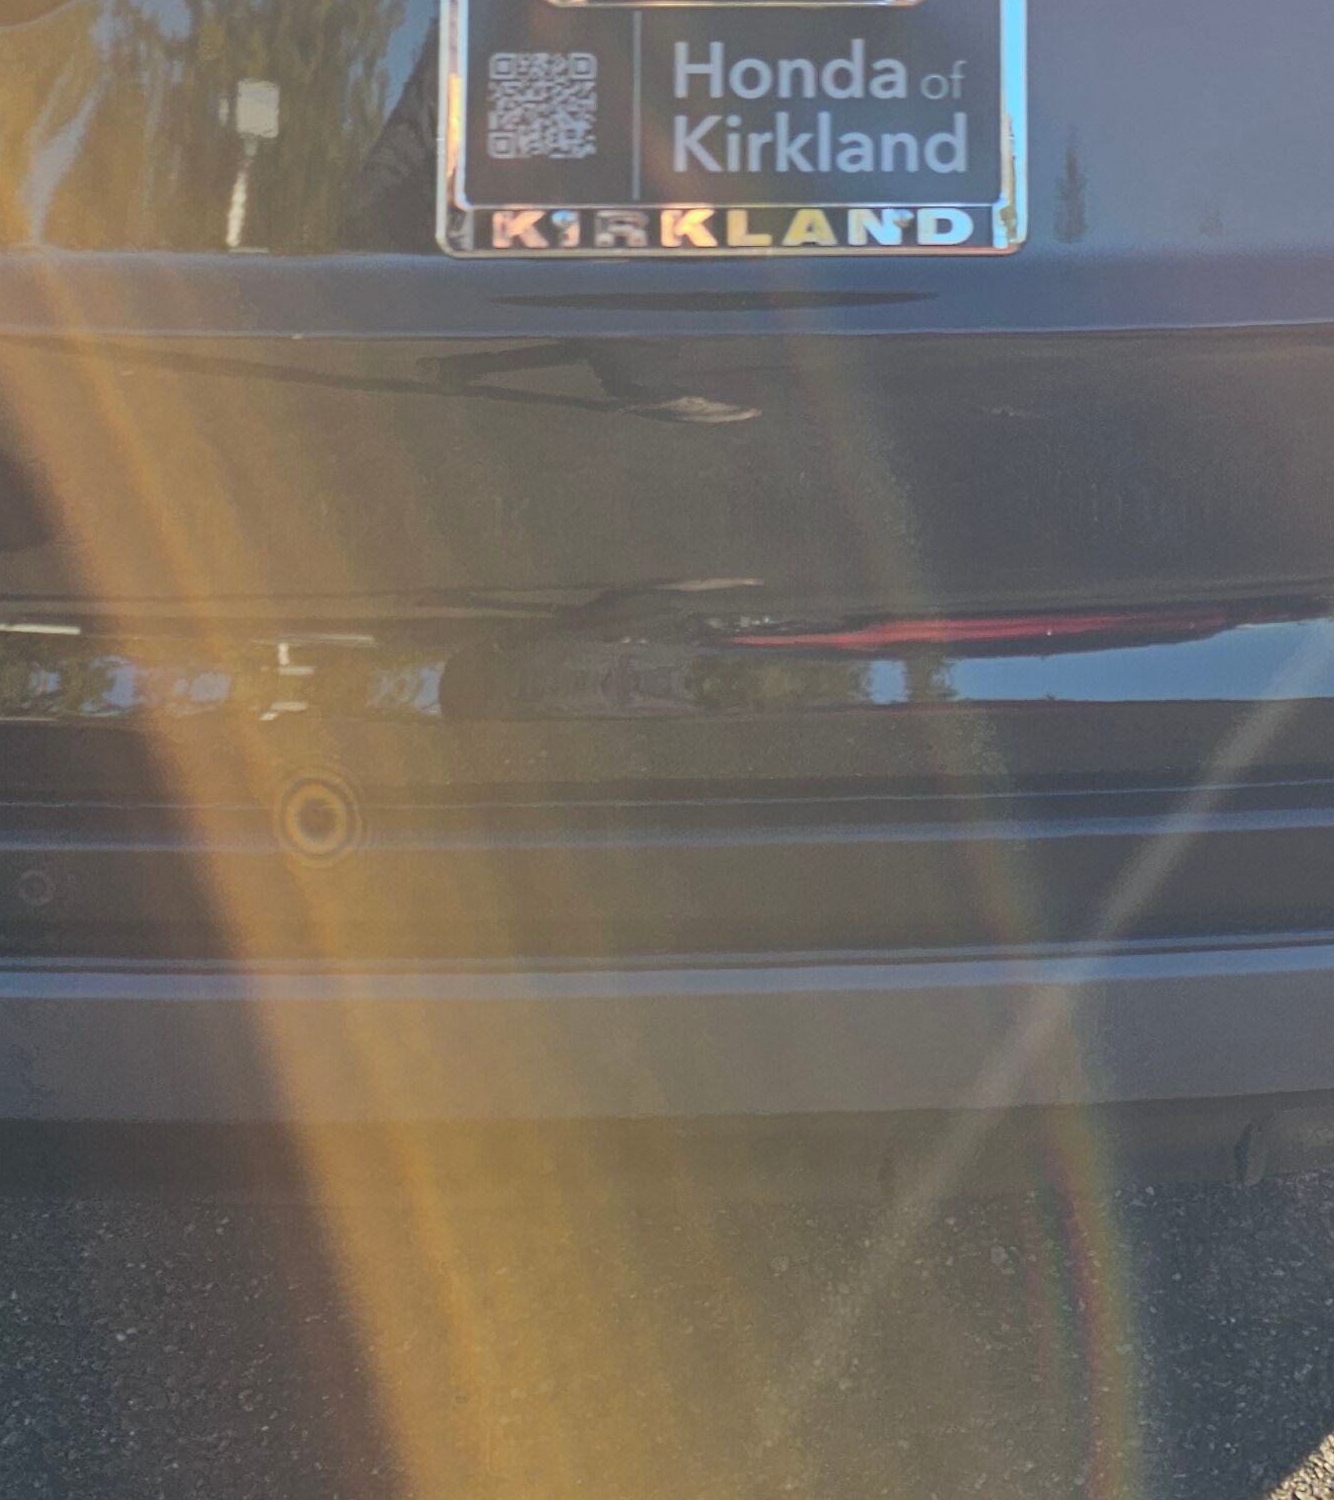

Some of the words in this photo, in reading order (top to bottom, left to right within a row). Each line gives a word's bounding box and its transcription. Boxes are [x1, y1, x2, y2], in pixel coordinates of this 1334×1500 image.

[673, 38, 908, 100] Honda
[920, 60, 967, 100] of
[673, 112, 967, 174] Kirkland
[491, 208, 974, 248] KIRKLAND
